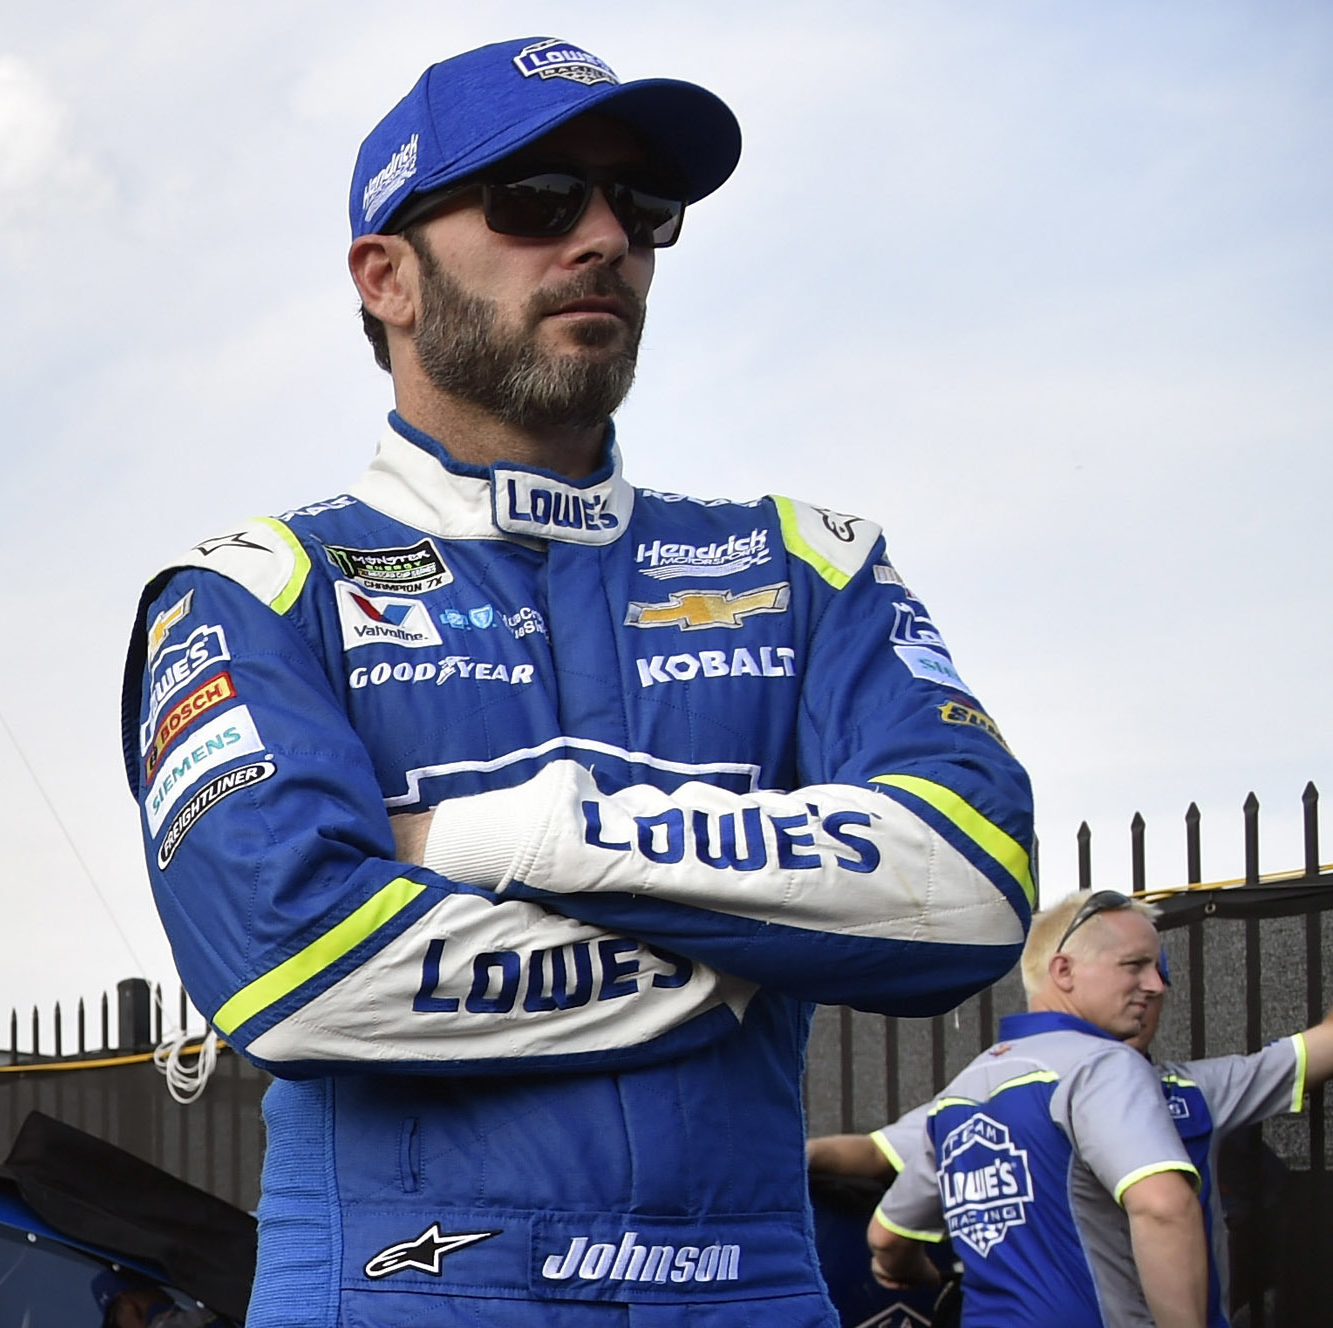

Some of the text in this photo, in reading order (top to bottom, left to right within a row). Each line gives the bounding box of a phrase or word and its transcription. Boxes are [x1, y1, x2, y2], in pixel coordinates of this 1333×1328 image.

[507, 478, 619, 532] LOWE'S
[636, 528, 768, 567] Hendrick
[364, 576, 443, 592] CHAMPION 7X
[354, 624, 424, 642] Valvoline
[349, 660, 535, 689] GOODYEAR
[636, 646, 797, 688] KOBALT
[161, 683, 223, 739] BOSCH
[152, 726, 242, 815] SIEMENS
[163, 767, 259, 855] FREIGHTLINER
[582, 801, 882, 873] LOWE'S
[947, 1120, 997, 1150] TEAM
[943, 1158, 1018, 1208] LOWE'S
[541, 1232, 740, 1284] Johnson
